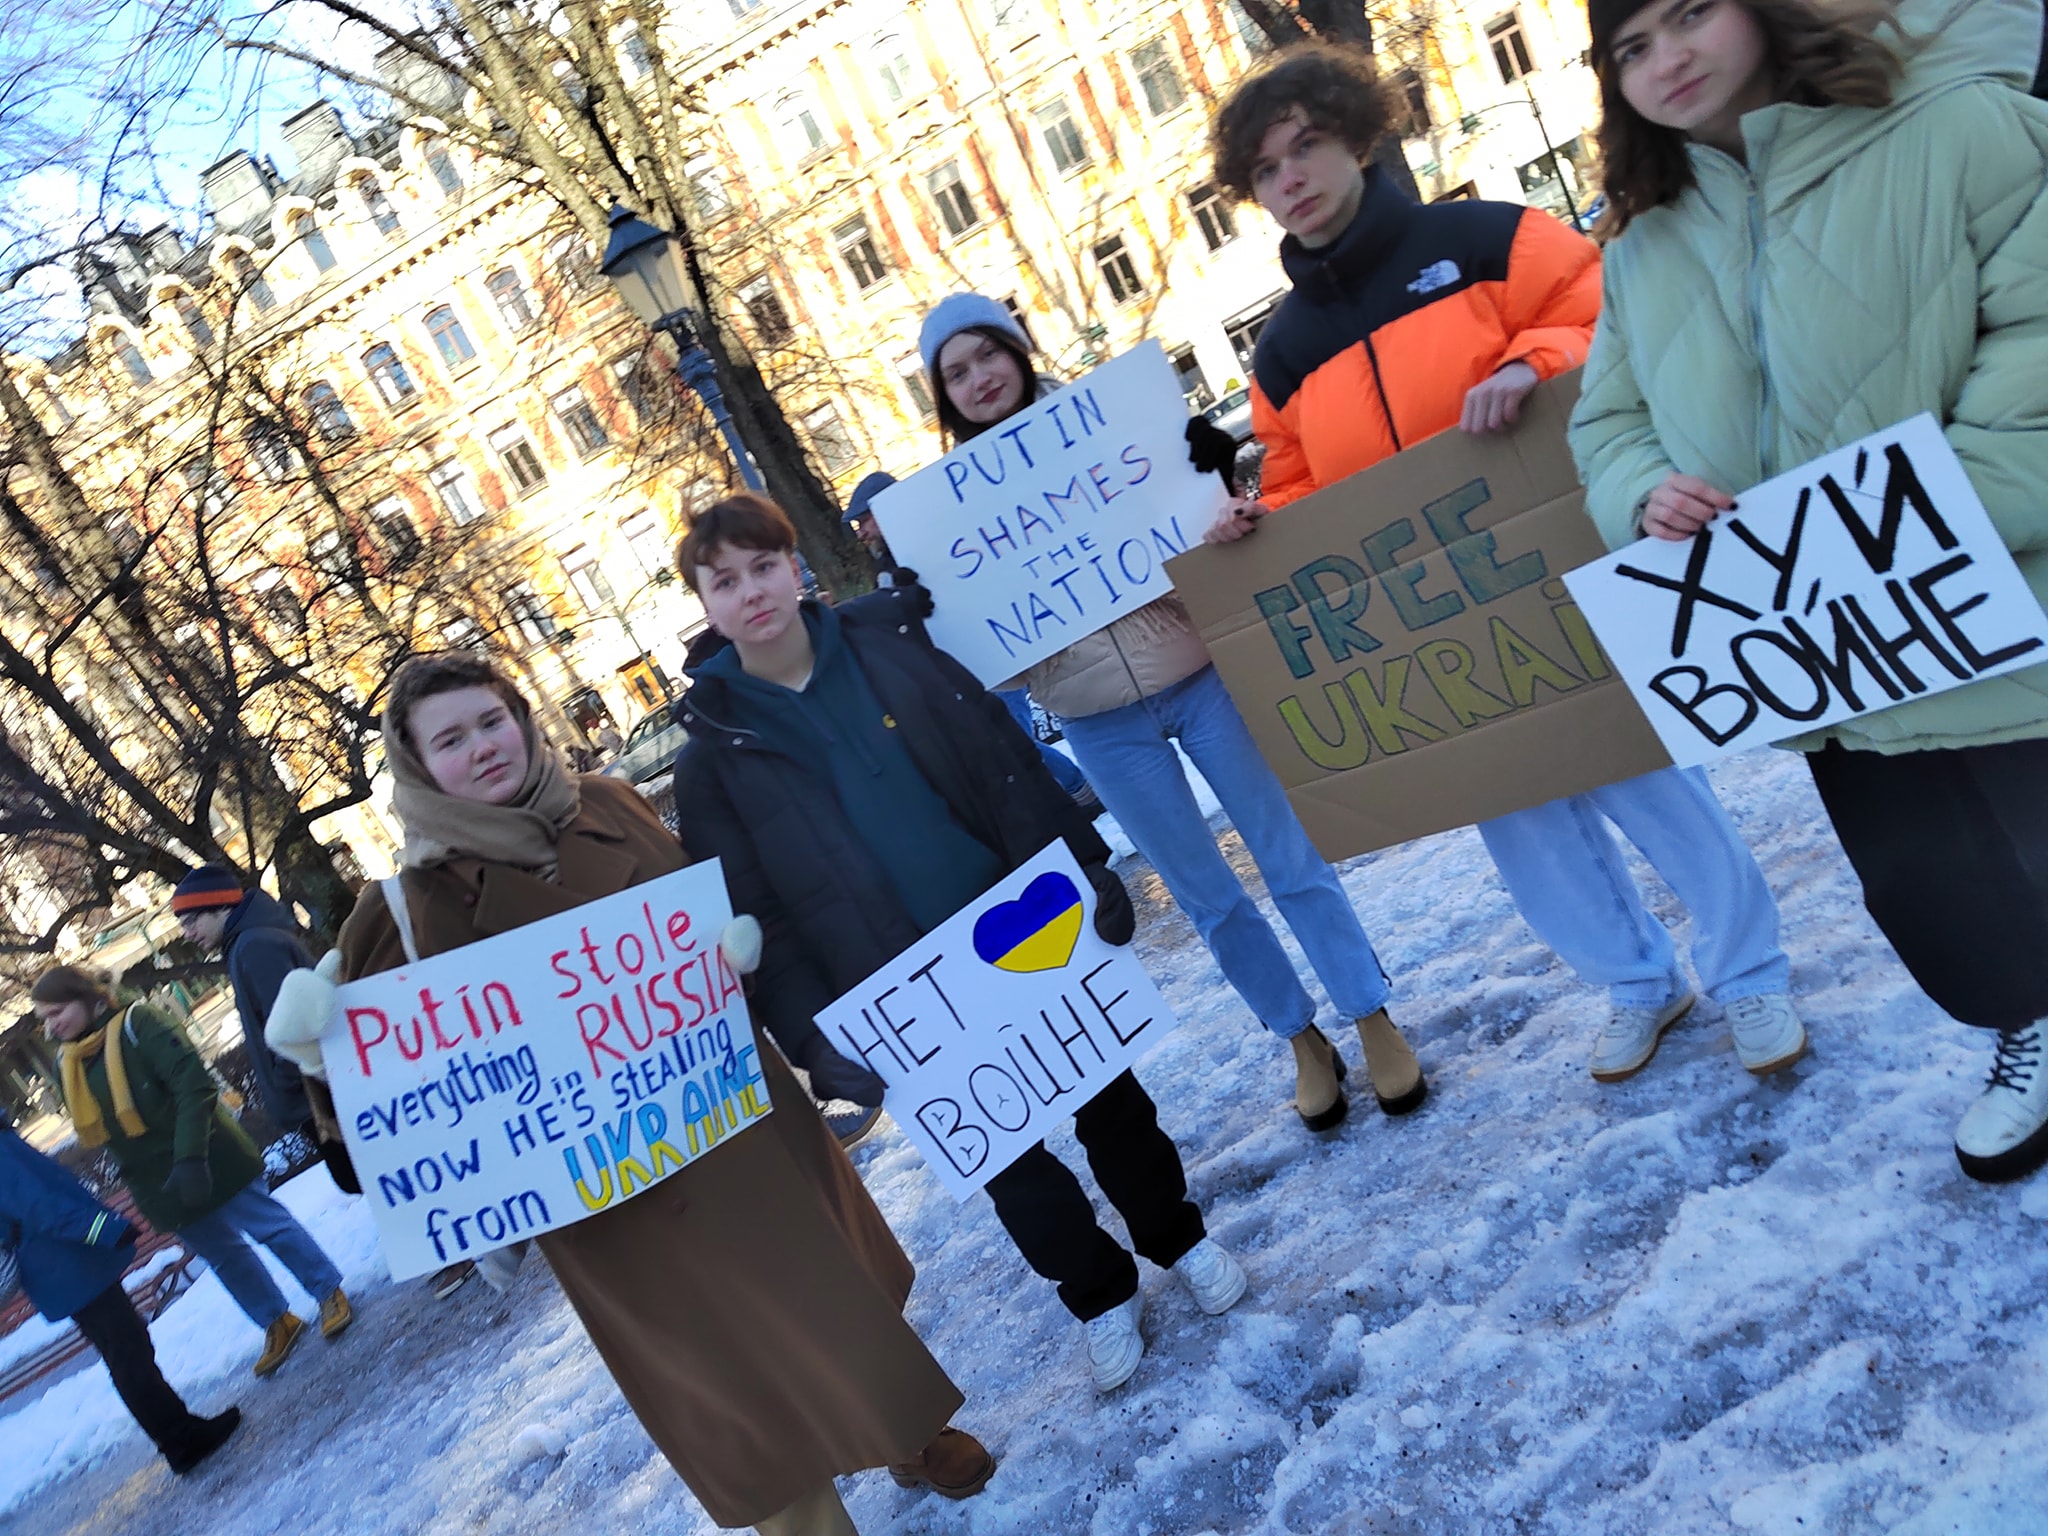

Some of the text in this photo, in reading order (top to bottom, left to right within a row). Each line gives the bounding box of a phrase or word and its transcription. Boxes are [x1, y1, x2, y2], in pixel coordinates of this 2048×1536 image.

[945, 388, 1107, 504] PUTIN
[950, 443, 1152, 580] SHAMES
[985, 515, 1189, 659] NATION
[1021, 531, 1099, 579] THE
[1253, 477, 1548, 679] FREE
[1615, 442, 1960, 660] ХУЙ
[1648, 553, 2046, 748] ВОЙНЕ
[345, 901, 697, 1077] Putin stole
[355, 942, 744, 1142] everything in RUSSIA
[838, 953, 967, 1090] НЕТ
[426, 1043, 771, 1263] from UKRAINE
